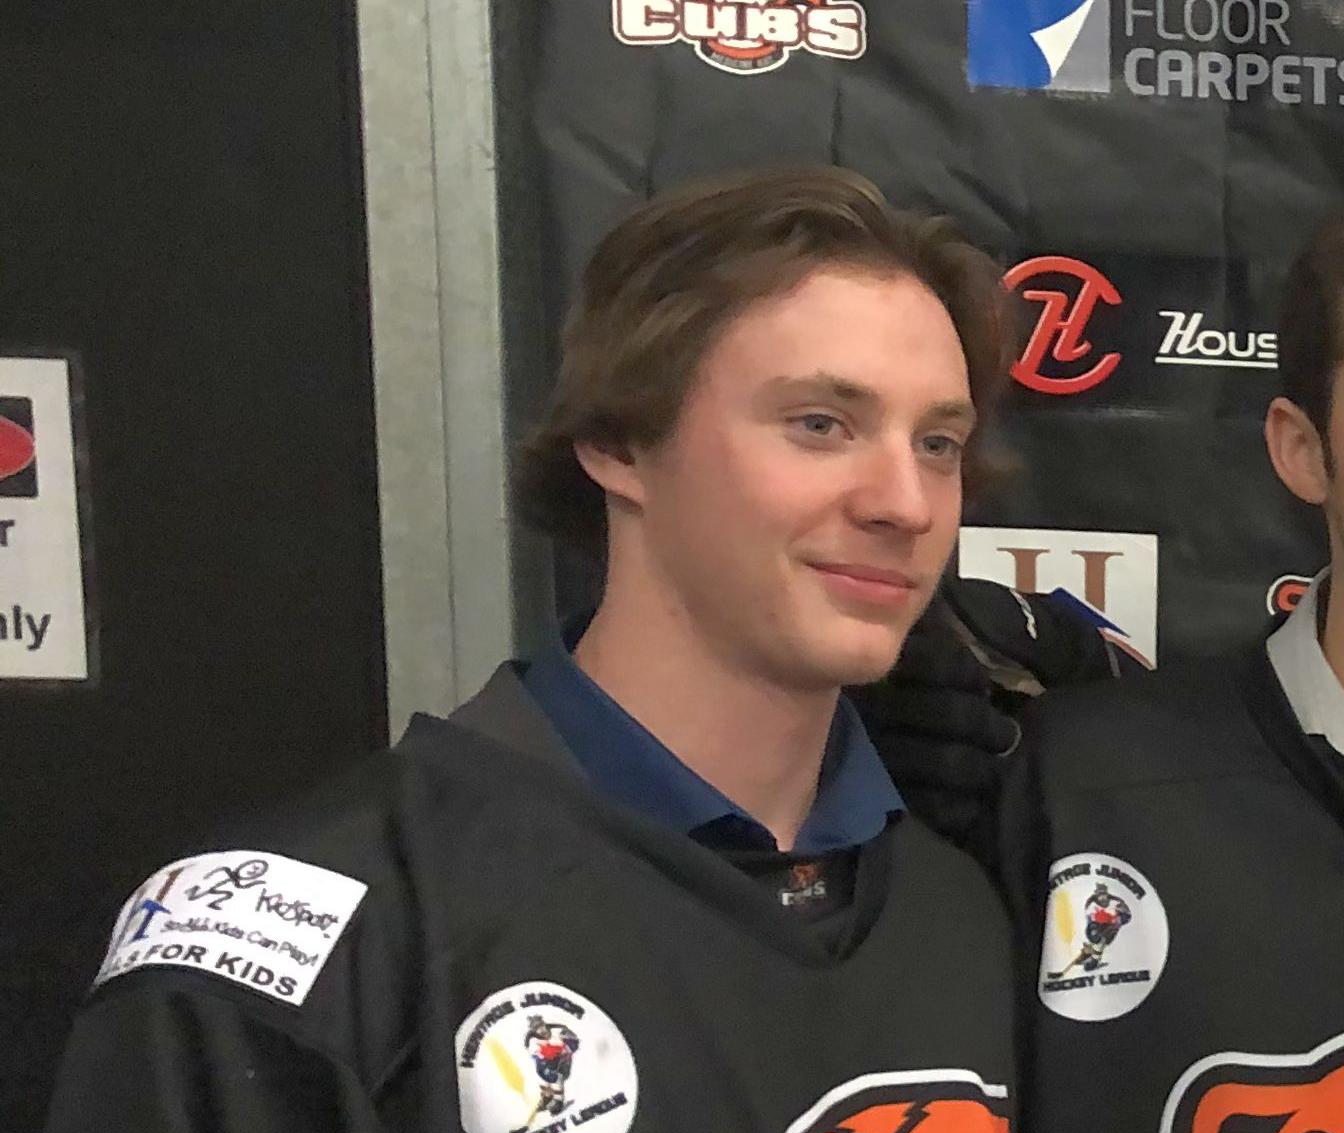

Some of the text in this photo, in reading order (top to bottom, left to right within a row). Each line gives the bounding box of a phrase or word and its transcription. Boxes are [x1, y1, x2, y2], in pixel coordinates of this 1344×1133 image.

[1126, 0, 1290, 45] FLOOR
[1157, 311, 1278, 358] HOUS
[215, 952, 297, 997] KIDS
